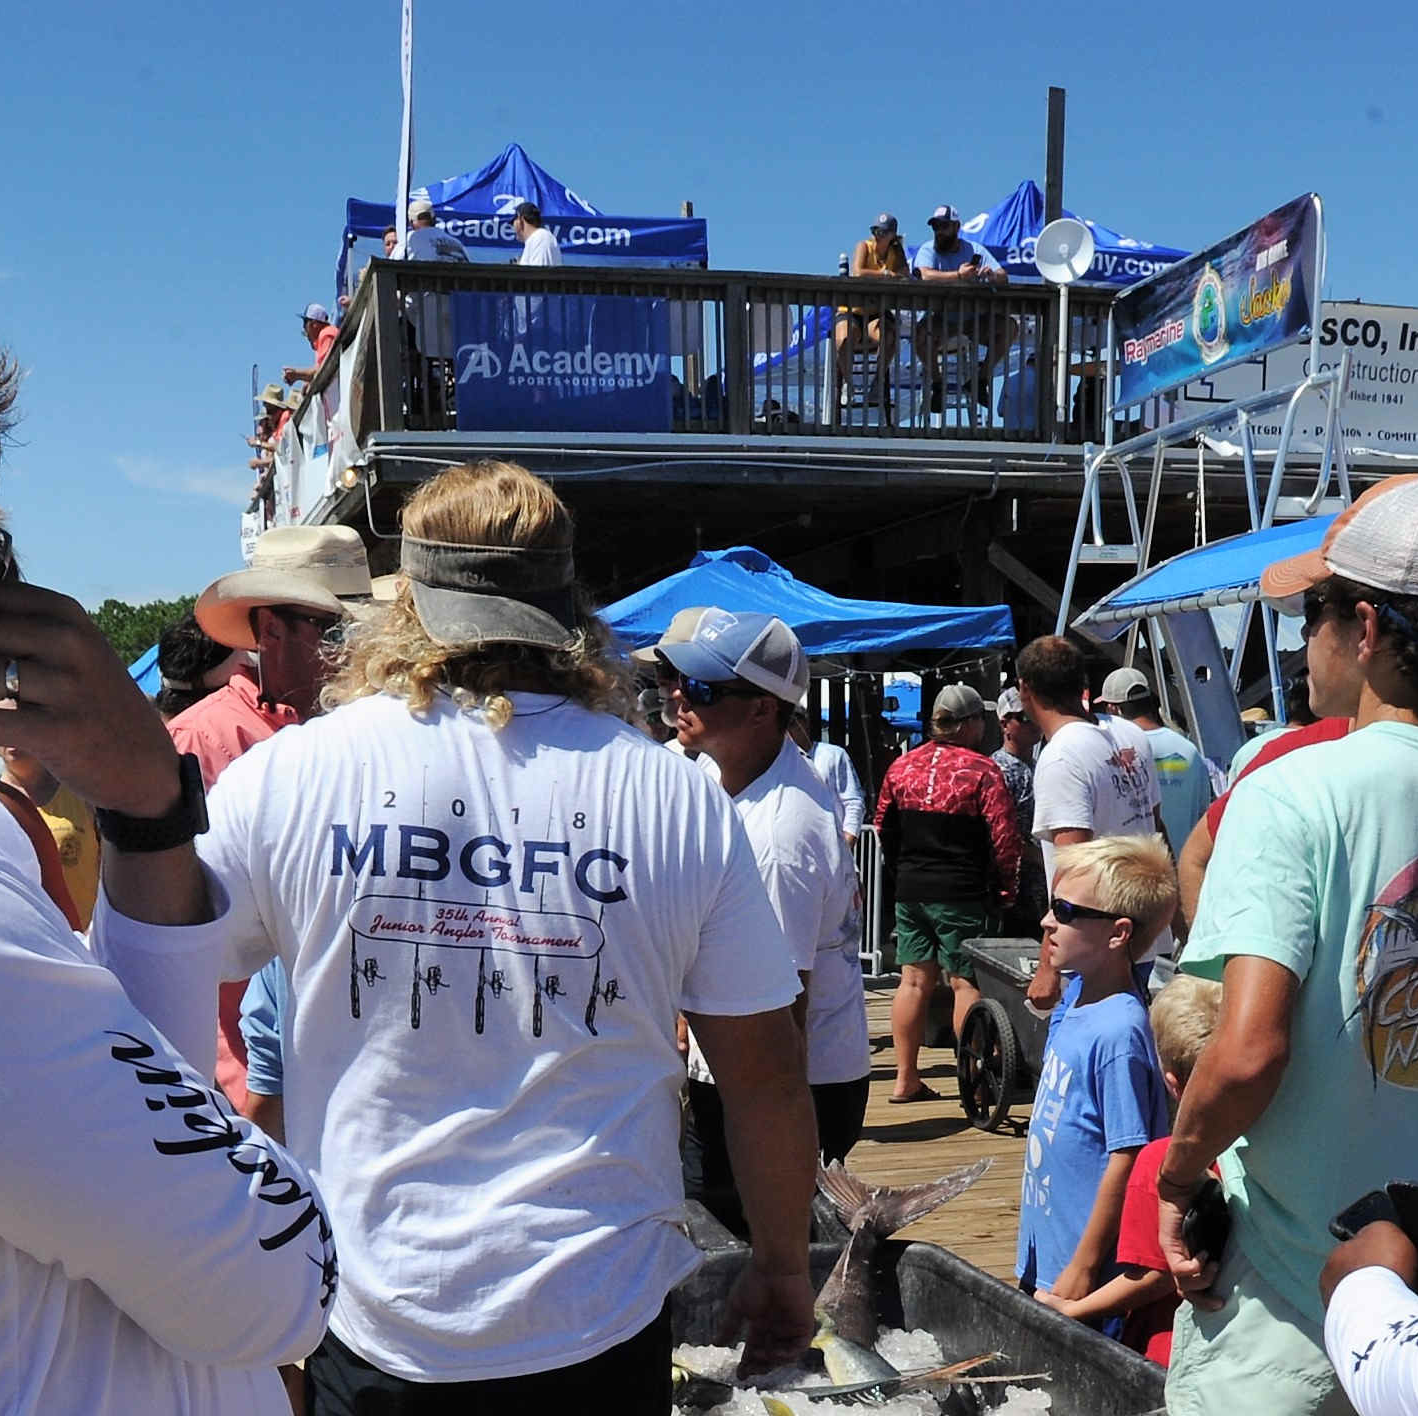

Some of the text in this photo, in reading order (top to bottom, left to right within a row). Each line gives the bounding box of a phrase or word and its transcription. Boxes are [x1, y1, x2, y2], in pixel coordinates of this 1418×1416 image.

[434, 215, 631, 247] acadey.com
[1124, 318, 1184, 366] Raymarine
[1301, 317, 1388, 355] SCO,
[507, 343, 661, 385] Academy
[1381, 392, 1404, 405] 1941
[330, 823, 630, 904] MBGFC
[369, 914, 583, 949] Junior Angler Tournament
[435, 907, 470, 922] 35th
